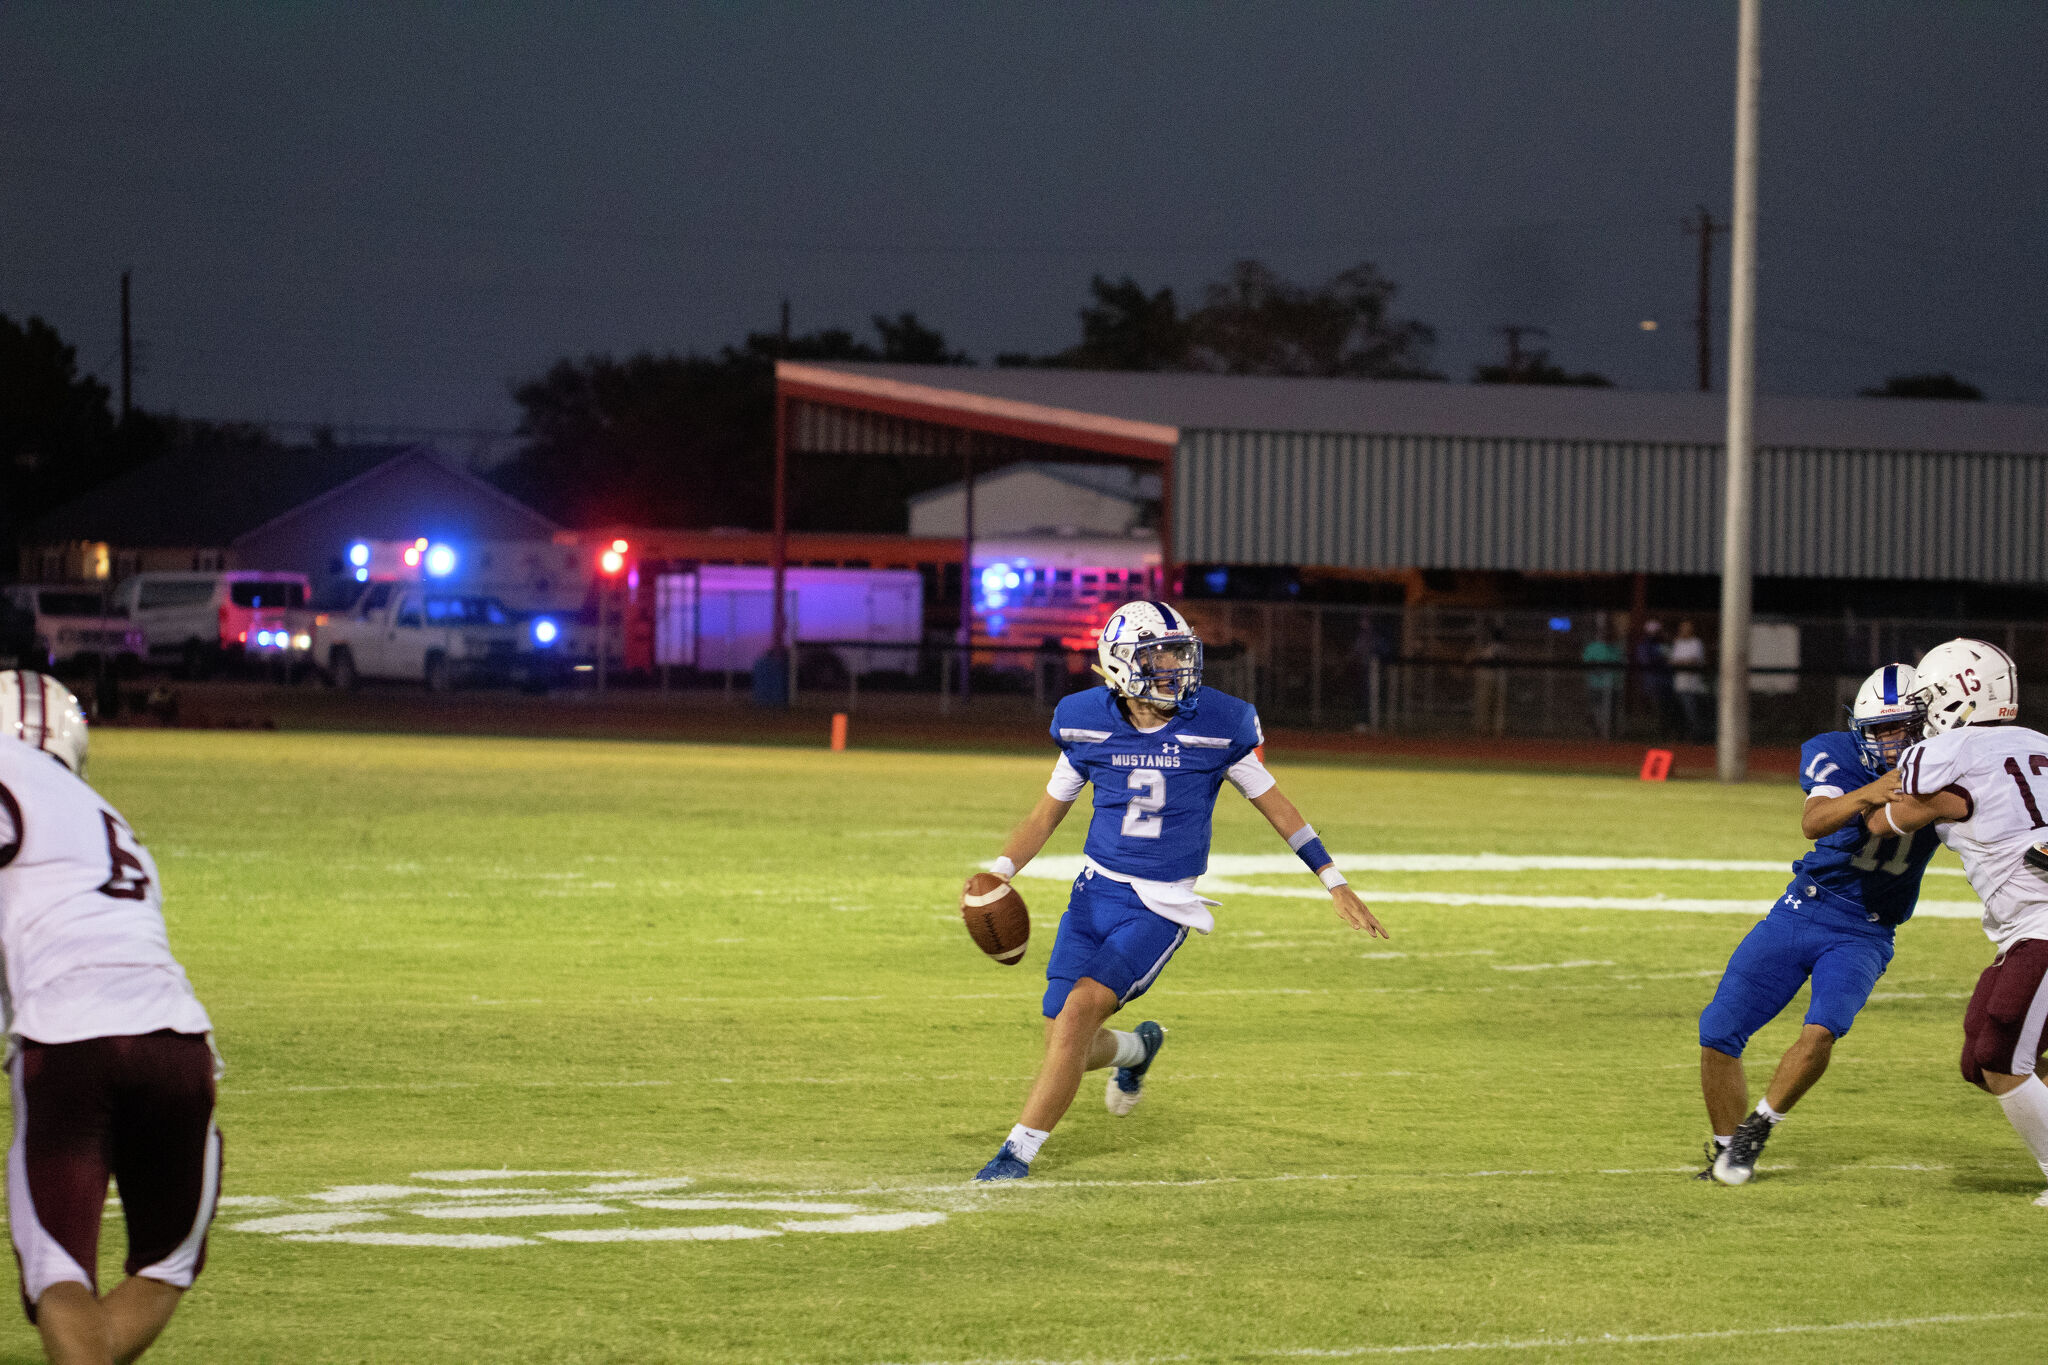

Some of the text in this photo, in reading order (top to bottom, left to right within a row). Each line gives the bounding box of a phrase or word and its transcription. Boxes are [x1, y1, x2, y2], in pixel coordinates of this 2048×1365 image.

[1955, 668, 1981, 696] 13
[1112, 754, 1181, 768] MUSTANGS
[1804, 751, 1840, 783] 11
[1120, 768, 1167, 839] 2
[1849, 832, 1911, 876] 11
